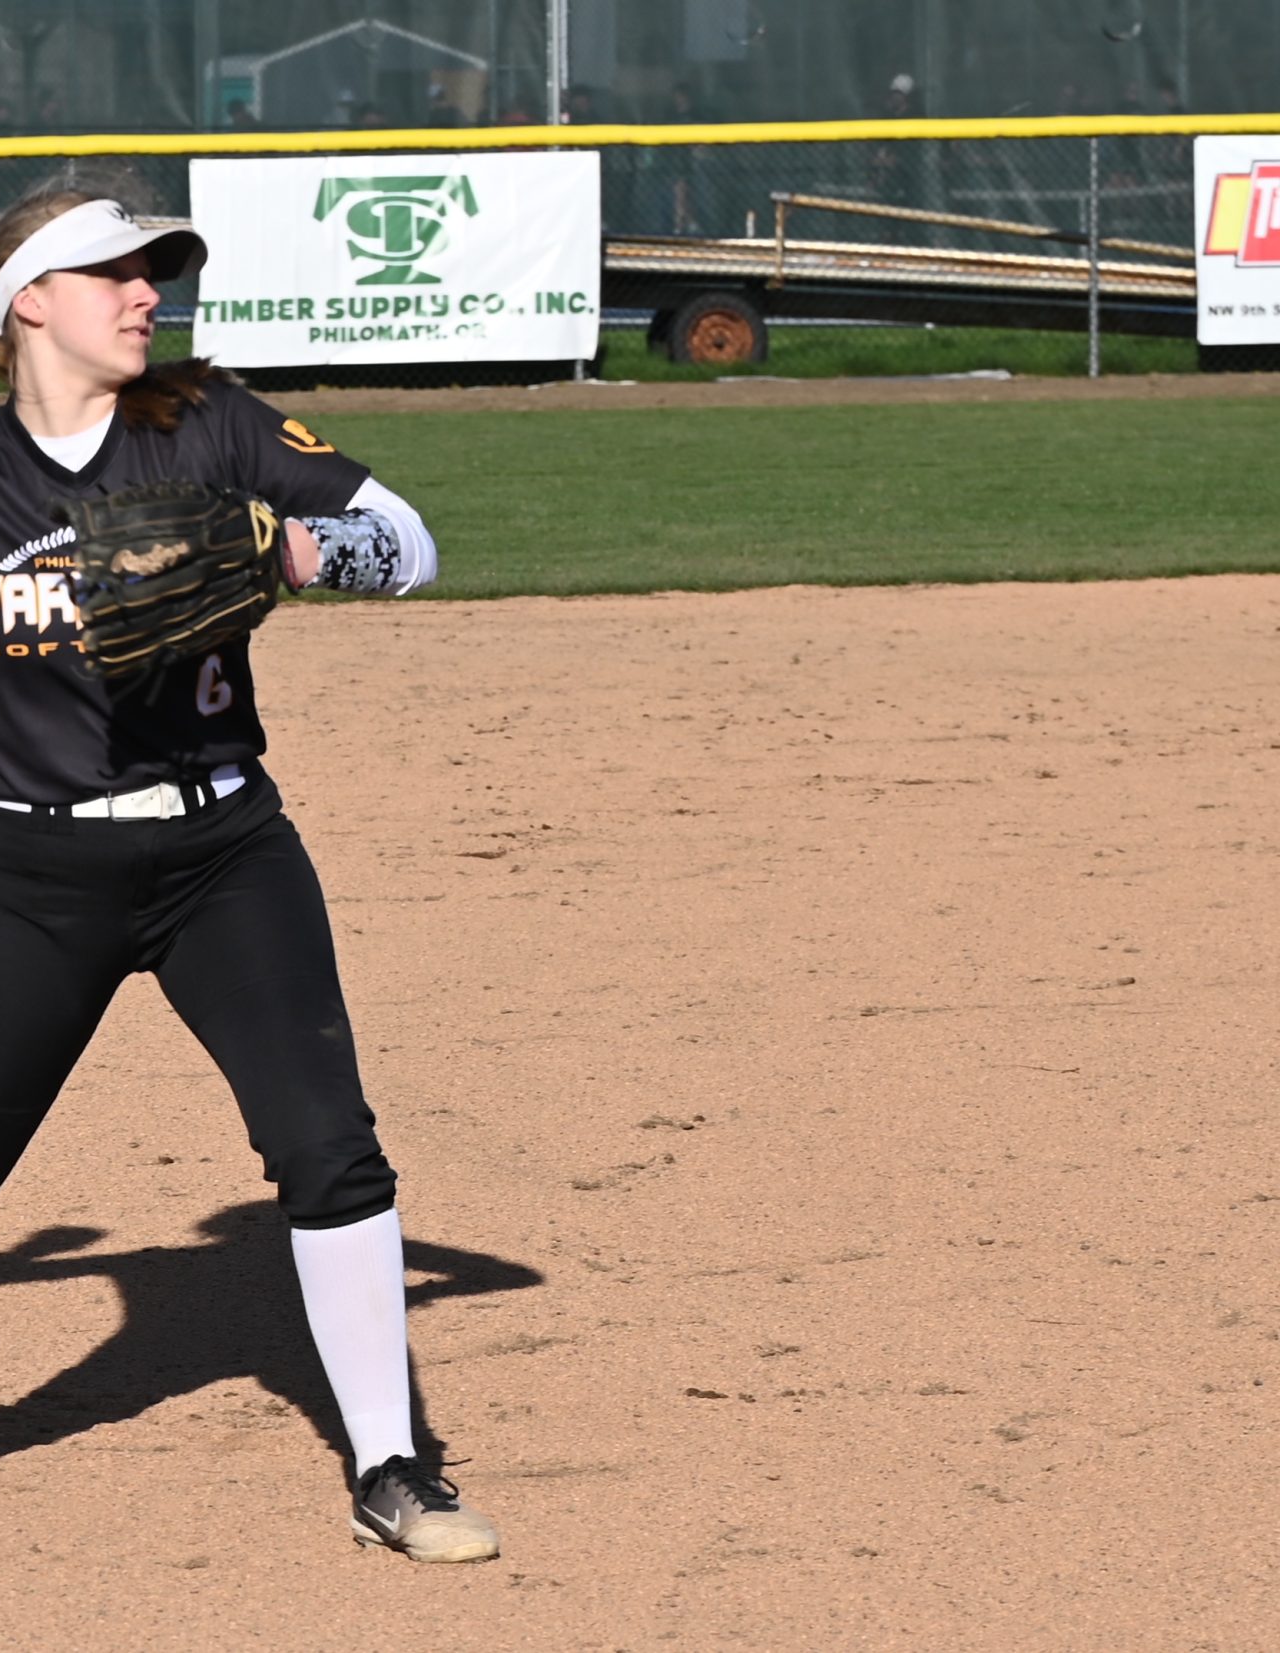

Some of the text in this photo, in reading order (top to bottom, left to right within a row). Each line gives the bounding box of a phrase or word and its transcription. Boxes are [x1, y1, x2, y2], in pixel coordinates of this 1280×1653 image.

[200, 297, 314, 323] TIMBER
[326, 294, 449, 321] SUPPLY
[535, 291, 595, 315] INC.
[196, 653, 232, 717] 6
